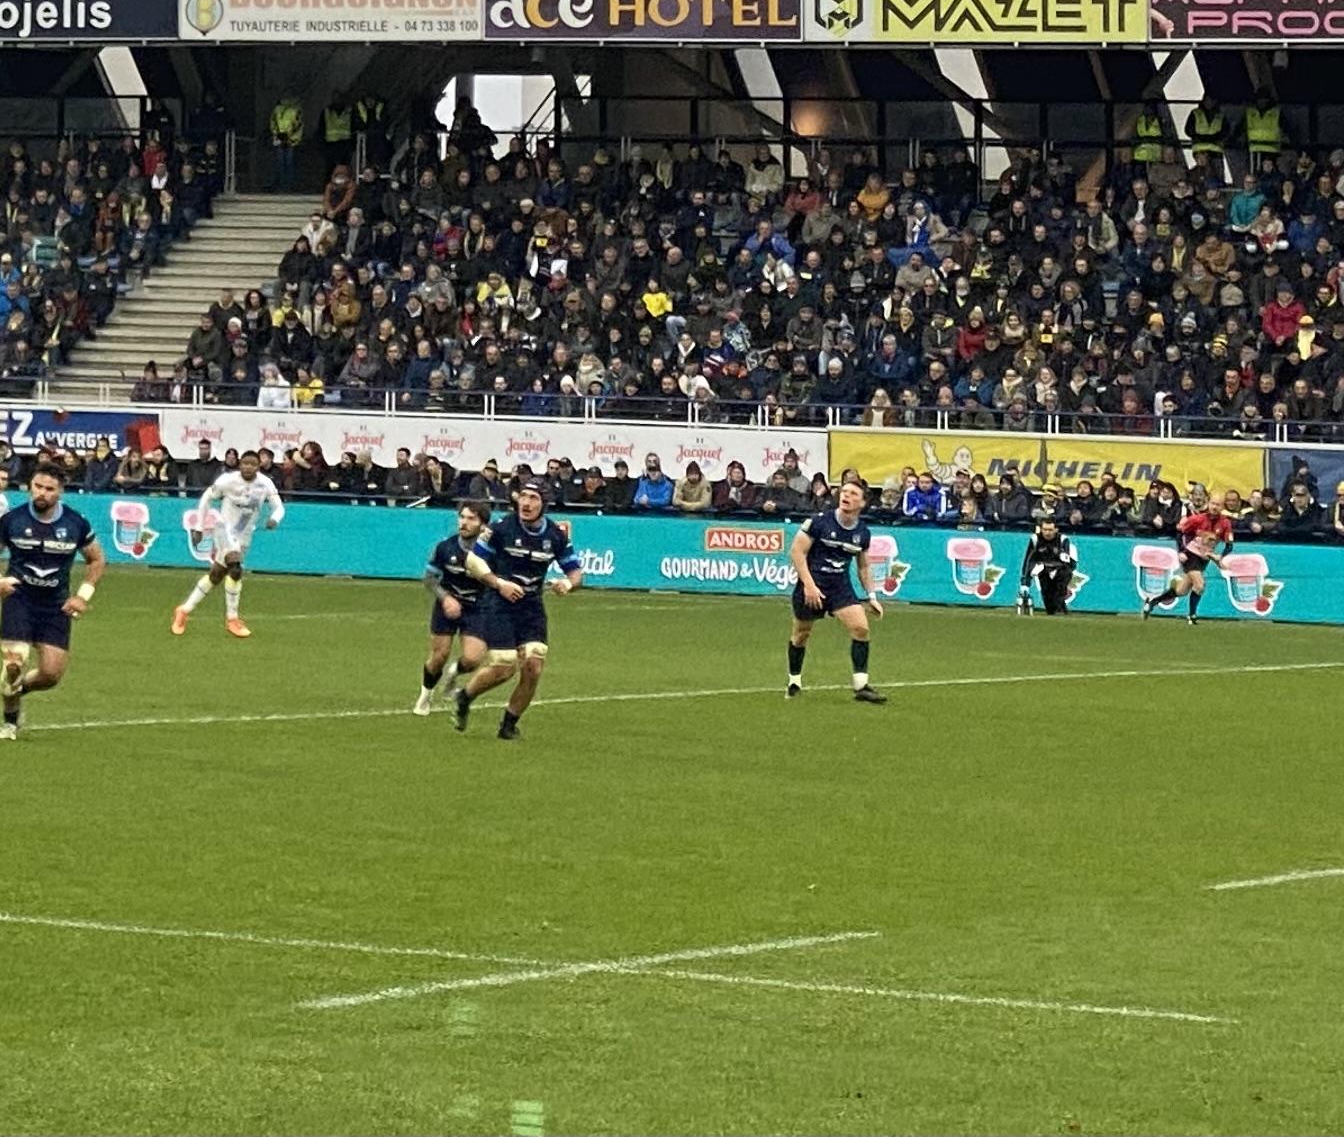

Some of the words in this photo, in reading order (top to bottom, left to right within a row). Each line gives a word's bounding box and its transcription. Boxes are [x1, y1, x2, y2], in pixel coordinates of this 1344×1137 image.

[230, 20, 300, 32] TUYAUTERIE
[306, 20, 388, 32] INDUSTRIELLE
[506, 434, 550, 457] Jacquet
[588, 438, 635, 459] Jacquet
[676, 441, 722, 463] Jacquet
[709, 530, 781, 550] ANDROS
[662, 556, 737, 581] GOURMAND
[740, 563, 754, 578] &
